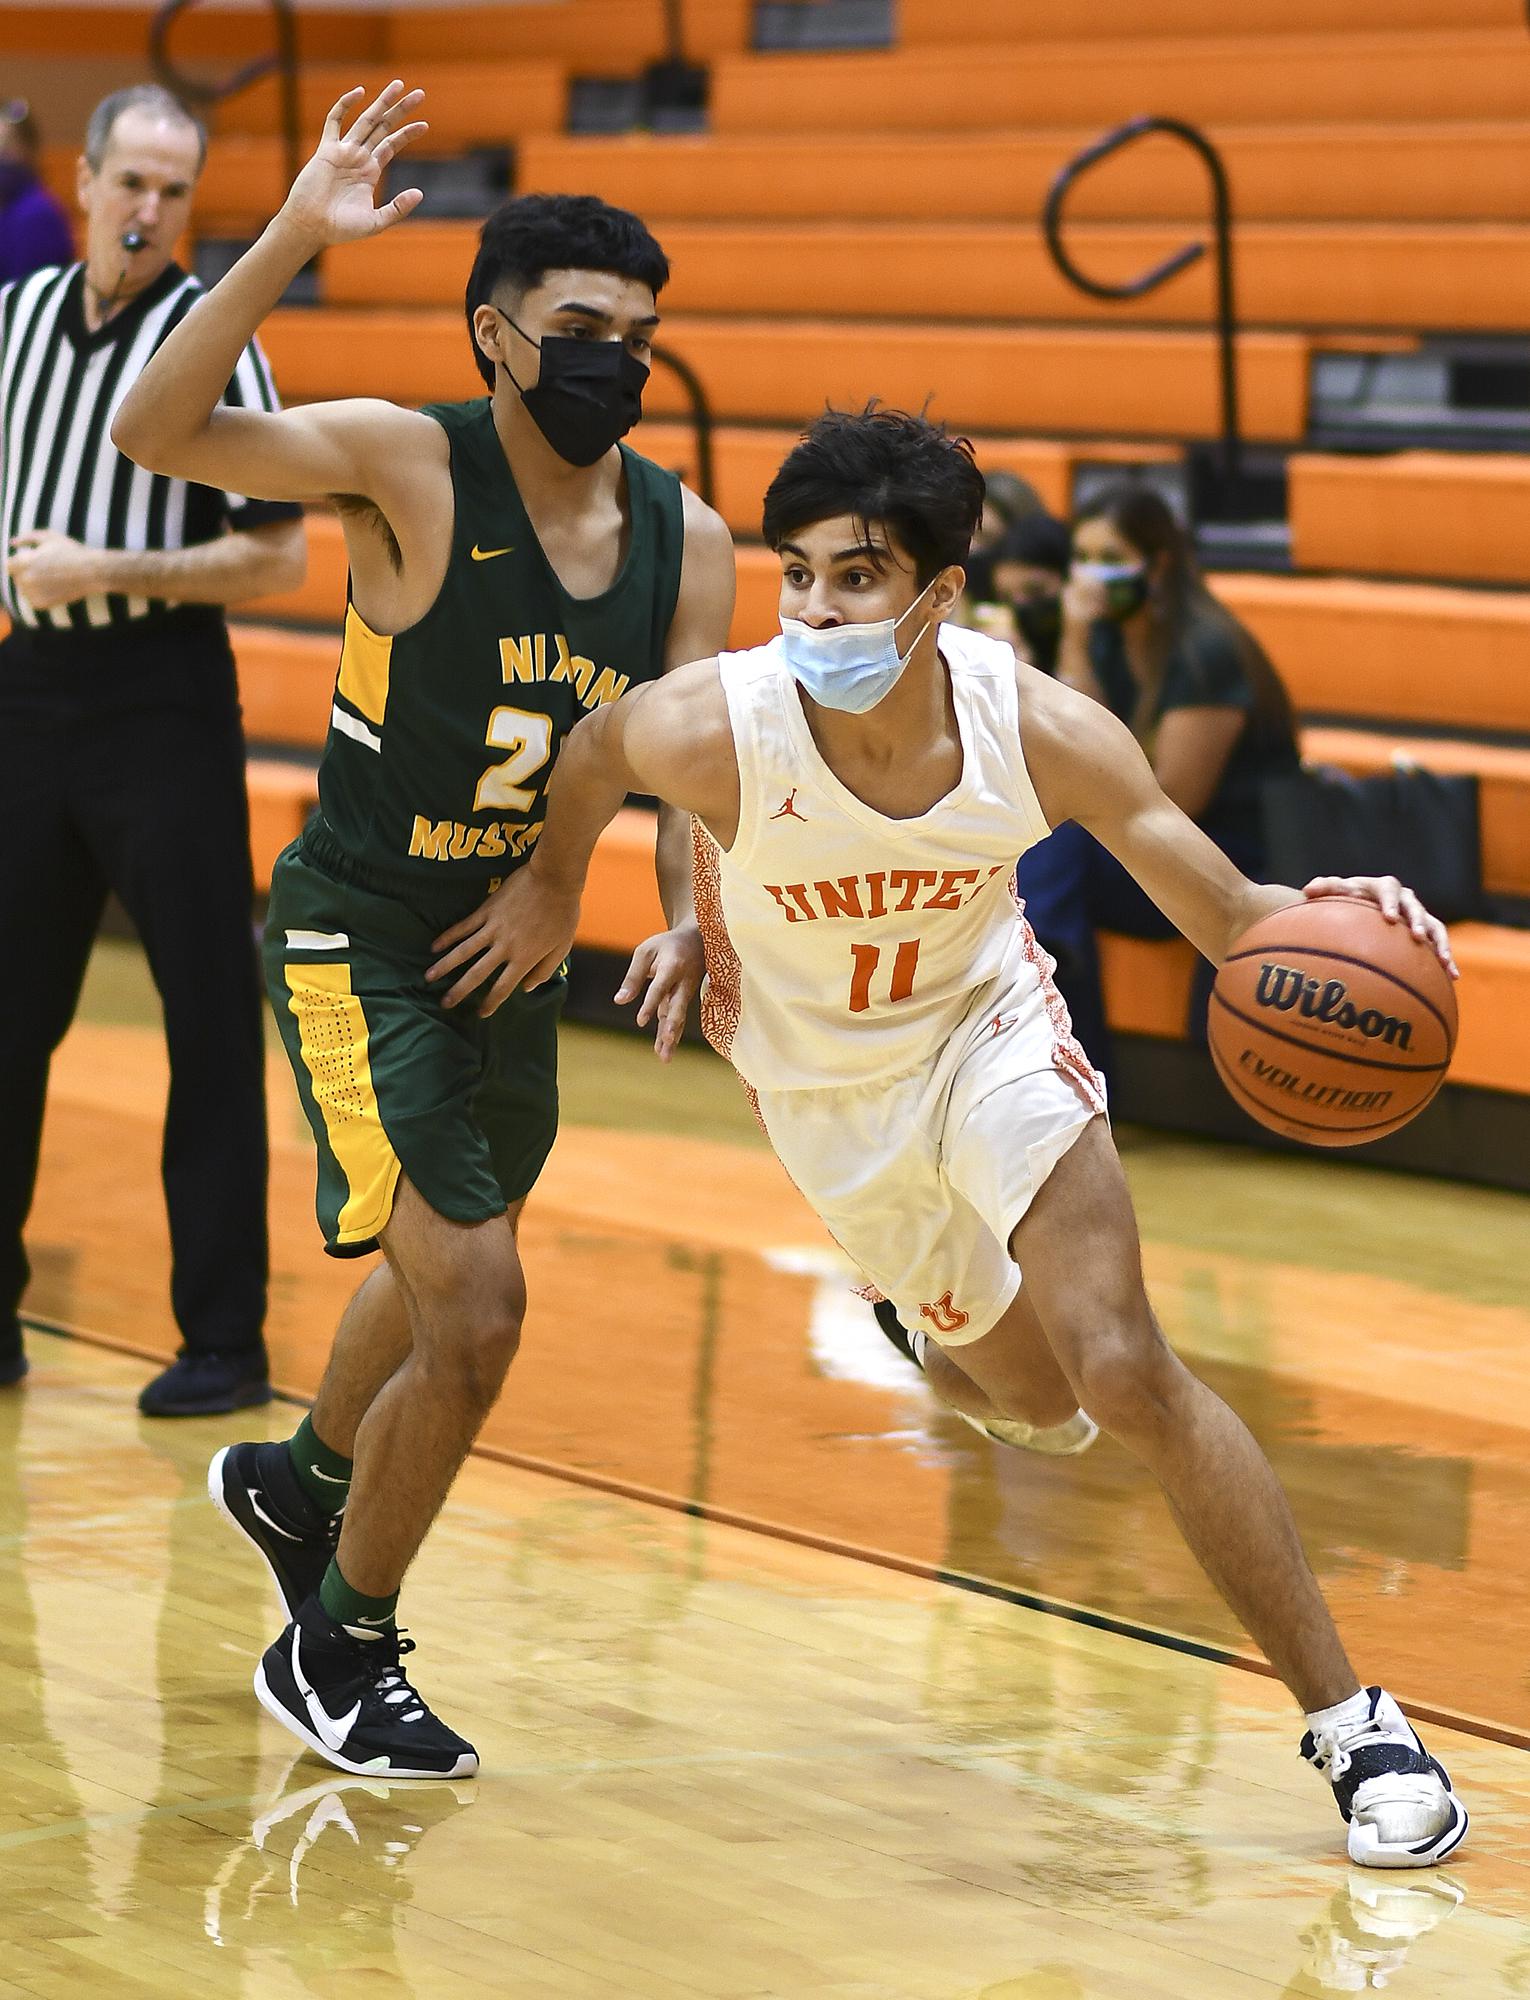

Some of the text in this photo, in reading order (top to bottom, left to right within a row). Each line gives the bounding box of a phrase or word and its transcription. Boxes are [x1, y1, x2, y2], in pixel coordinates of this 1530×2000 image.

[499, 633, 630, 709] NIXON
[472, 705, 567, 813] 2
[763, 865, 1004, 922] UNITE
[849, 938, 920, 1012] 11
[1256, 963, 1412, 1051] Wilson
[1240, 1049, 1393, 1109] EVOLUTION
